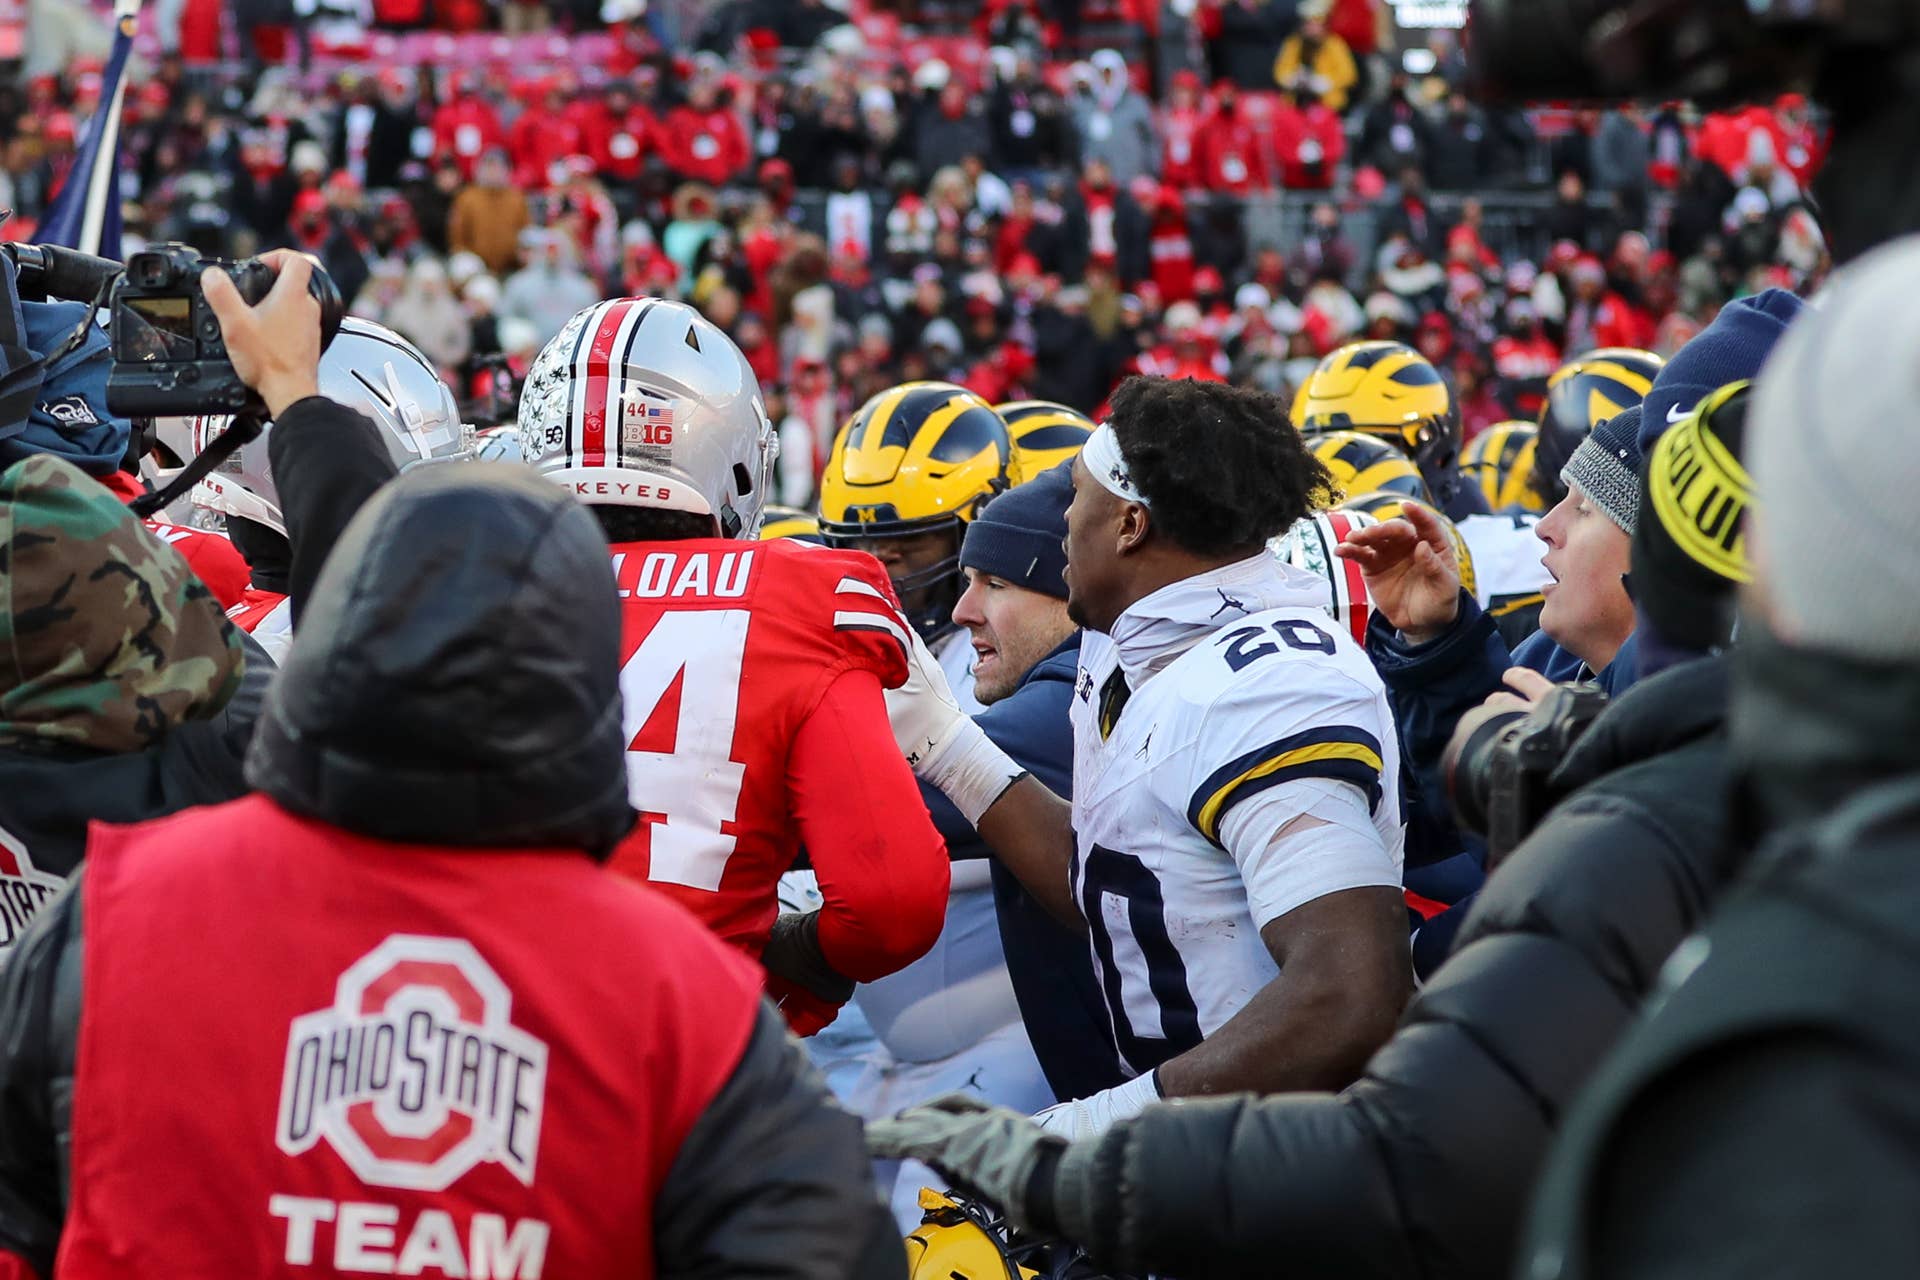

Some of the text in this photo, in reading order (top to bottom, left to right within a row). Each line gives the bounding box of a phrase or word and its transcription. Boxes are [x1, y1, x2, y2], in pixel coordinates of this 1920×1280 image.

[627, 403, 646, 417] 44
[857, 508, 877, 523] M
[1214, 619, 1337, 673] 20
[906, 752, 920, 766] M
[290, 1010, 535, 1164] OHIO STATE
[268, 1193, 551, 1280] TEAM
